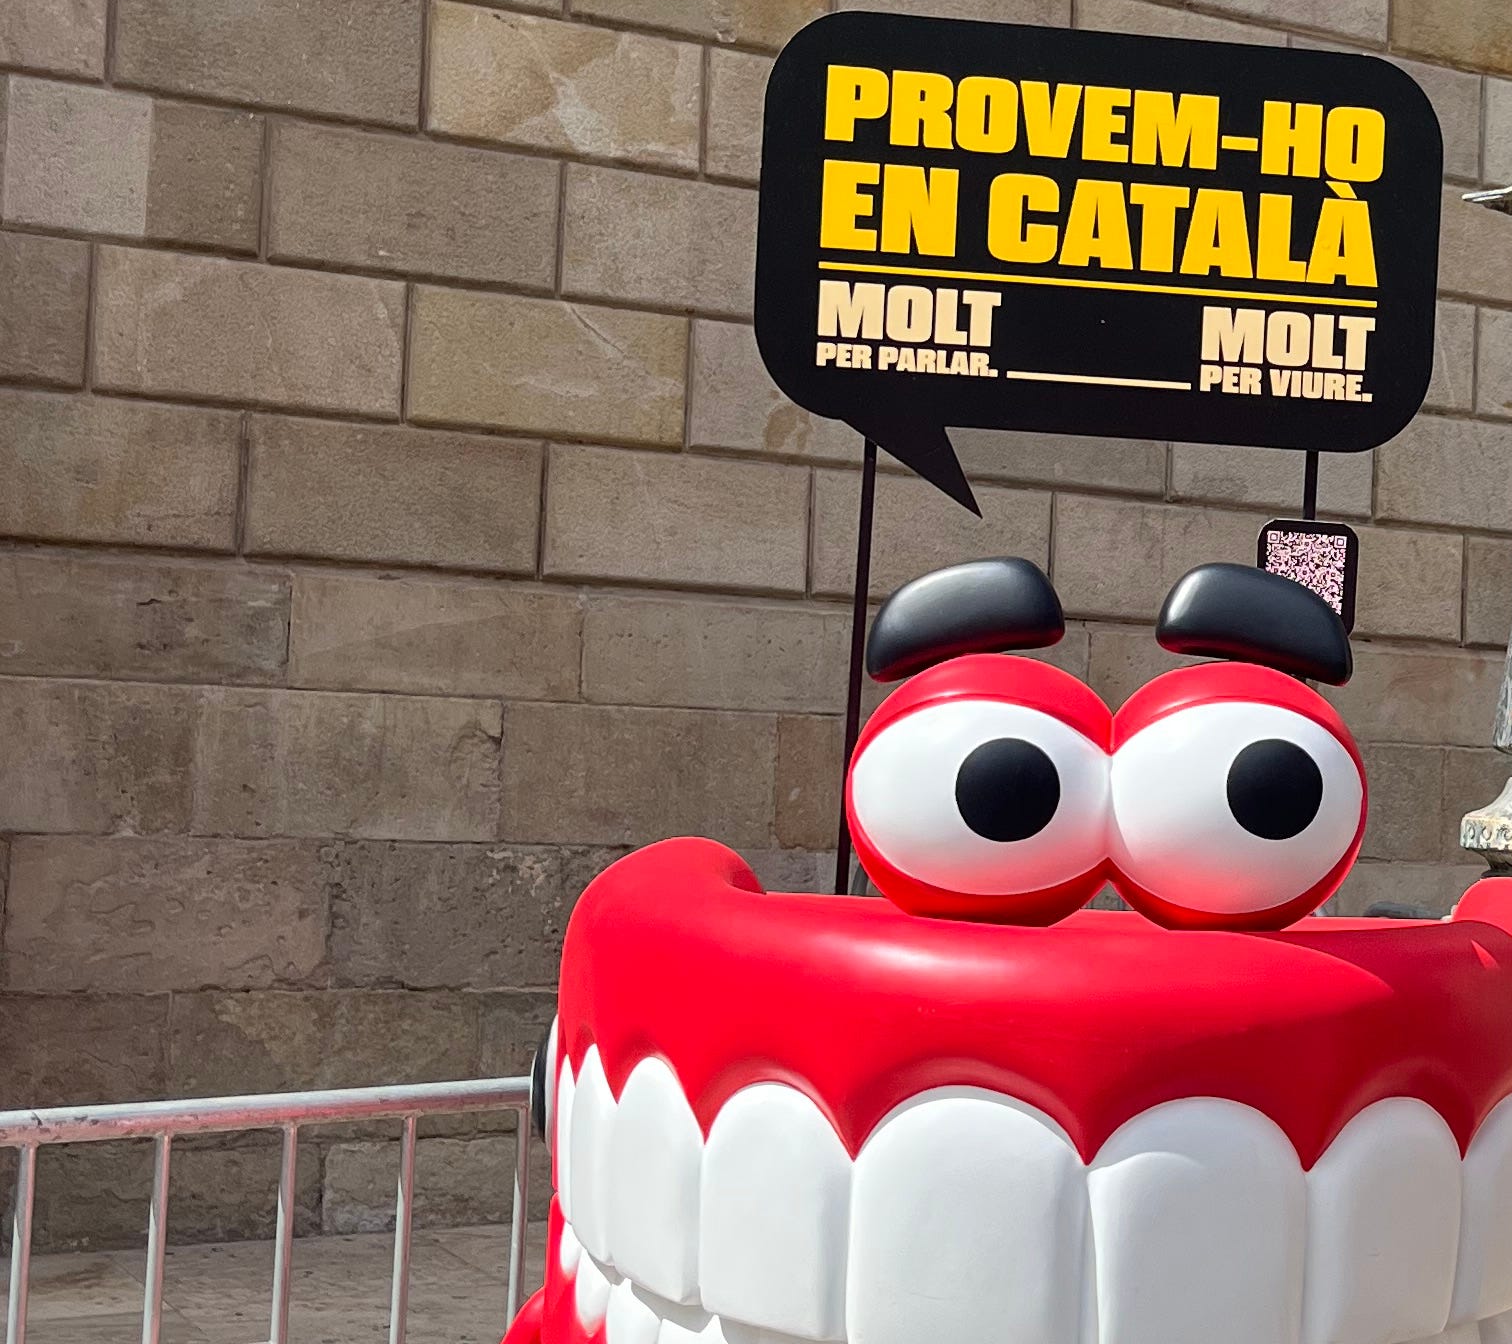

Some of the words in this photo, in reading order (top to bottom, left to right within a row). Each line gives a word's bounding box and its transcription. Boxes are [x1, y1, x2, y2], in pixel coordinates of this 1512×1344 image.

[824, 64, 1386, 183] PROVEM-HO
[819, 158, 960, 258] EN
[987, 172, 1379, 288] CATALÀ
[817, 279, 1002, 347] MOLT
[1200, 305, 1376, 371] MOLT
[815, 341, 873, 370] PER
[877, 345, 999, 379] PARLAR.
[1199, 364, 1262, 395] PER
[1269, 368, 1373, 403] VIURE.
